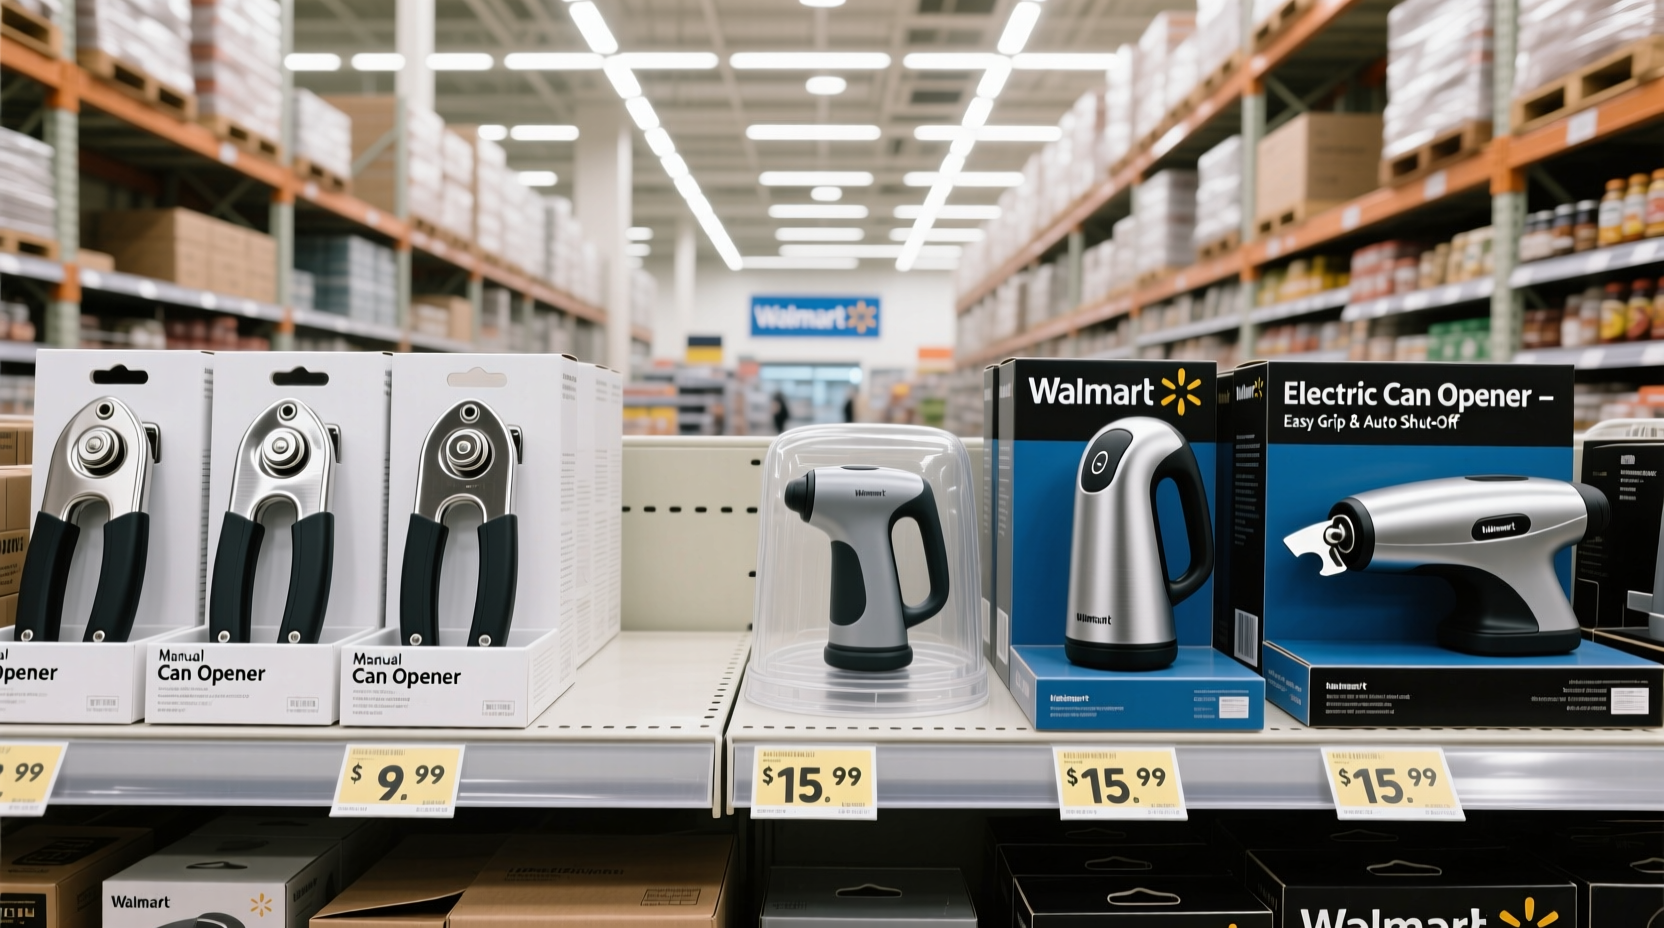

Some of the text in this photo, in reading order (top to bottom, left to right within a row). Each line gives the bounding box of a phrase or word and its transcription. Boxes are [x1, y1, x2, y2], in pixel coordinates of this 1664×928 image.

[754, 304, 846, 330] Walmart
[1028, 376, 1155, 406] Walmart
[1284, 380, 1378, 406] Electric
[1383, 382, 1431, 407] Can
[1437, 382, 1533, 413] Opener
[1283, 413, 1461, 433] Easy Grip & Auto Shut-Off
[158, 648, 204, 662] Manual
[353, 652, 402, 666] Manual
[0, 665, 59, 685] pener
[157, 664, 266, 686] Can Opener
[352, 667, 462, 689] Can Opener
[110, 895, 171, 909] Walmart
